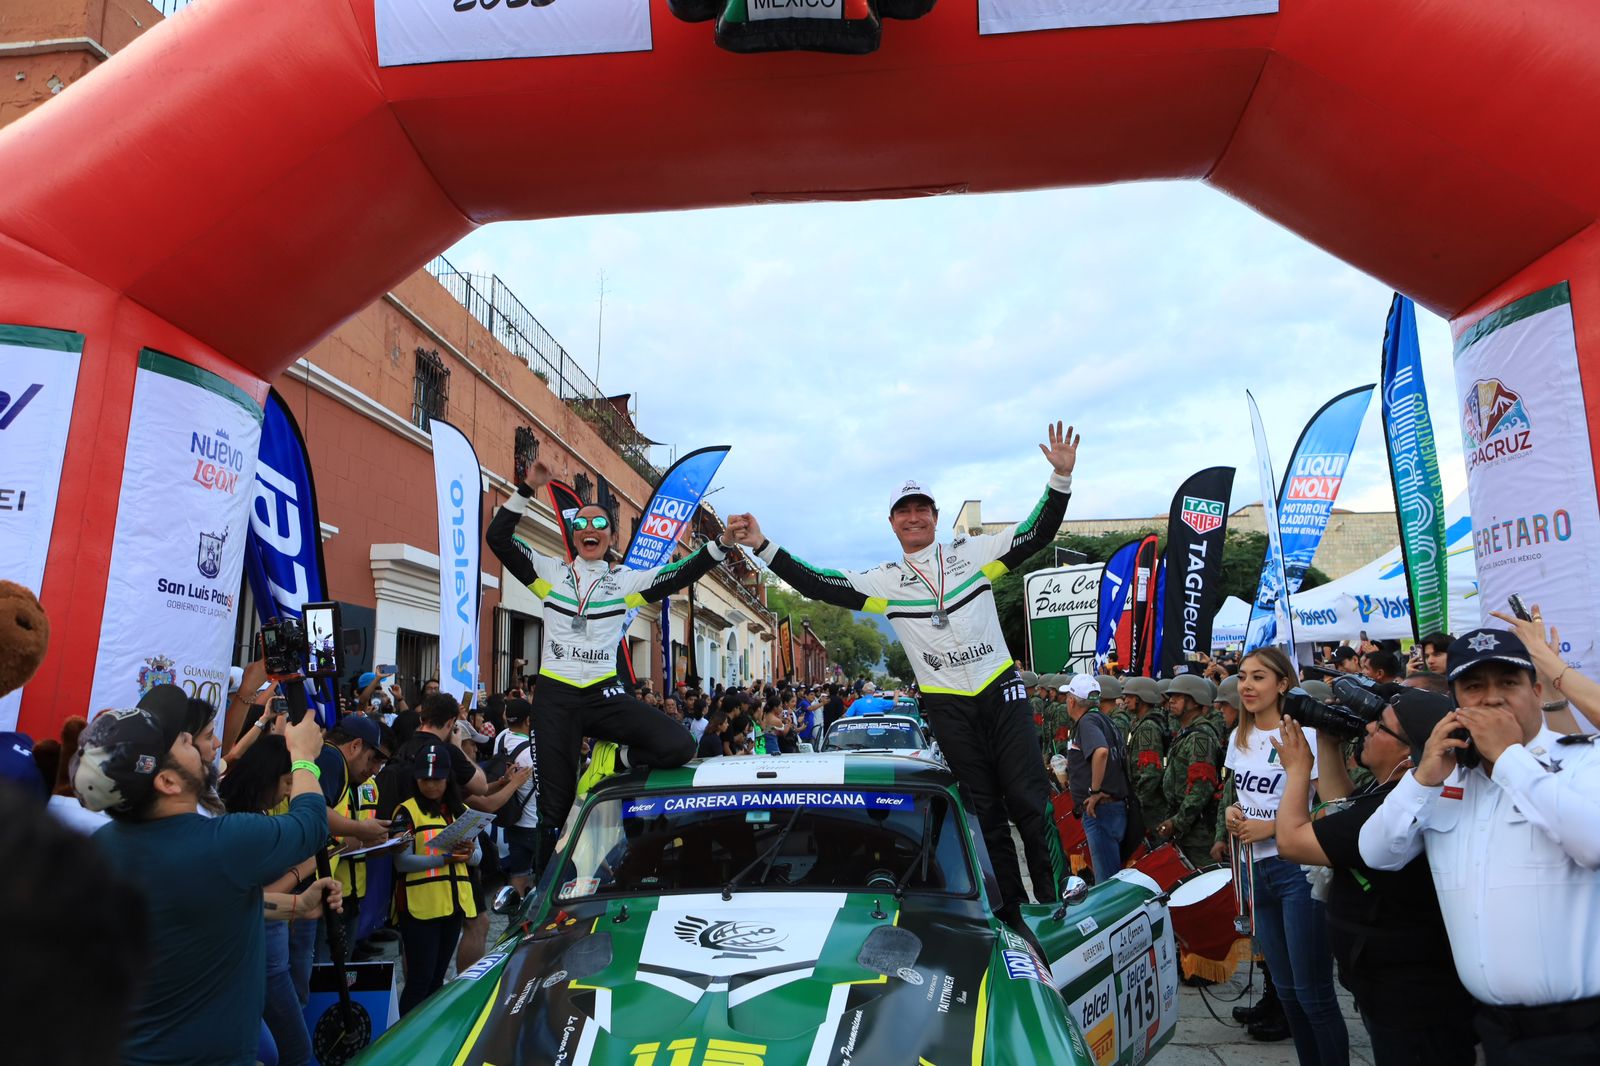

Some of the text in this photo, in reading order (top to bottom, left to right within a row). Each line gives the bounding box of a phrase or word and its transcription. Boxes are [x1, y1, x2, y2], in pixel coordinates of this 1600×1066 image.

[1414, 393, 1441, 484] ALIMENTICIOS
[1296, 456, 1345, 476] LIQUI
[1289, 478, 1340, 498] MOLY
[652, 497, 693, 520] LIQU
[1187, 498, 1221, 515] TAG
[1282, 503, 1312, 514] MOTOR
[1183, 512, 1220, 530] HEUER
[636, 536, 663, 550] MOTOR
[157, 578, 185, 596] San
[188, 583, 209, 601] Luis
[1039, 578, 1062, 596] La
[166, 599, 199, 613] GOBIERNO
[199, 607, 207, 615] DE
[1296, 608, 1338, 626] Valero
[1376, 595, 1411, 619] Vale
[572, 646, 610, 661] Kalida
[947, 642, 995, 665] Kalida
[628, 793, 904, 813] telcel CARRERA PANAMERICANA telcel
[1126, 956, 1147, 991] telcel
[1082, 984, 1110, 1028] telcel
[1124, 975, 1155, 1041] 115
